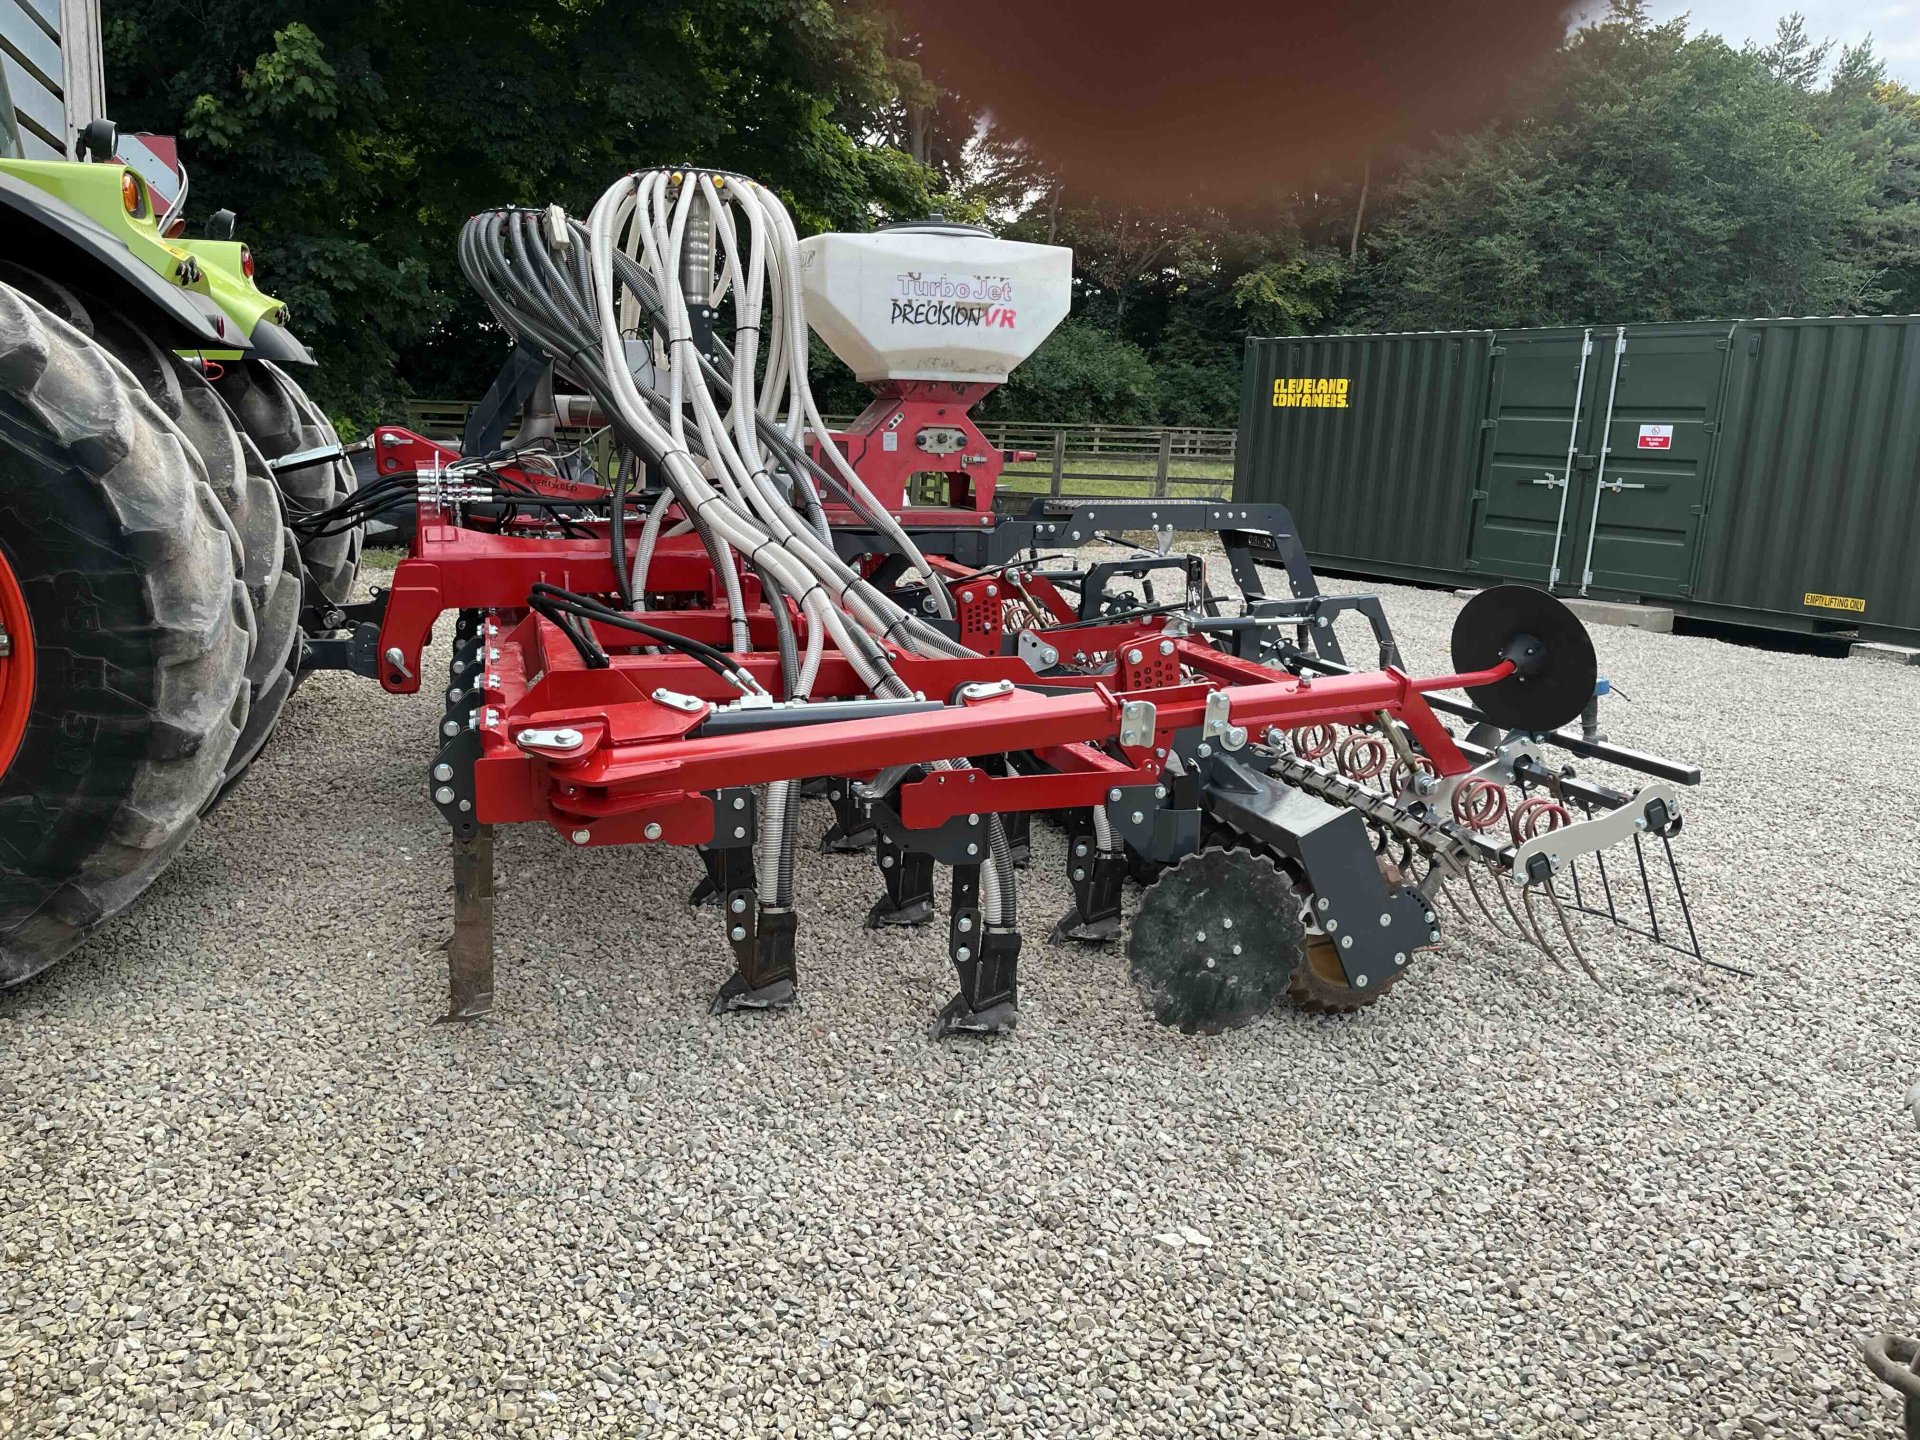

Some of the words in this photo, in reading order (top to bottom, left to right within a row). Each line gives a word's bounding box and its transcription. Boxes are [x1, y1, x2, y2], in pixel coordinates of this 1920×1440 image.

[897, 274, 970, 299] Turbo
[973, 279, 1012, 302] Jet
[891, 302, 981, 327] PRECISION
[984, 307, 1017, 329] VR
[1274, 378, 1349, 394] CLEVELAND
[1805, 594, 1825, 606] EMPTY
[1824, 596, 1849, 608] LIFTING
[1849, 599, 1864, 610] ONLY
